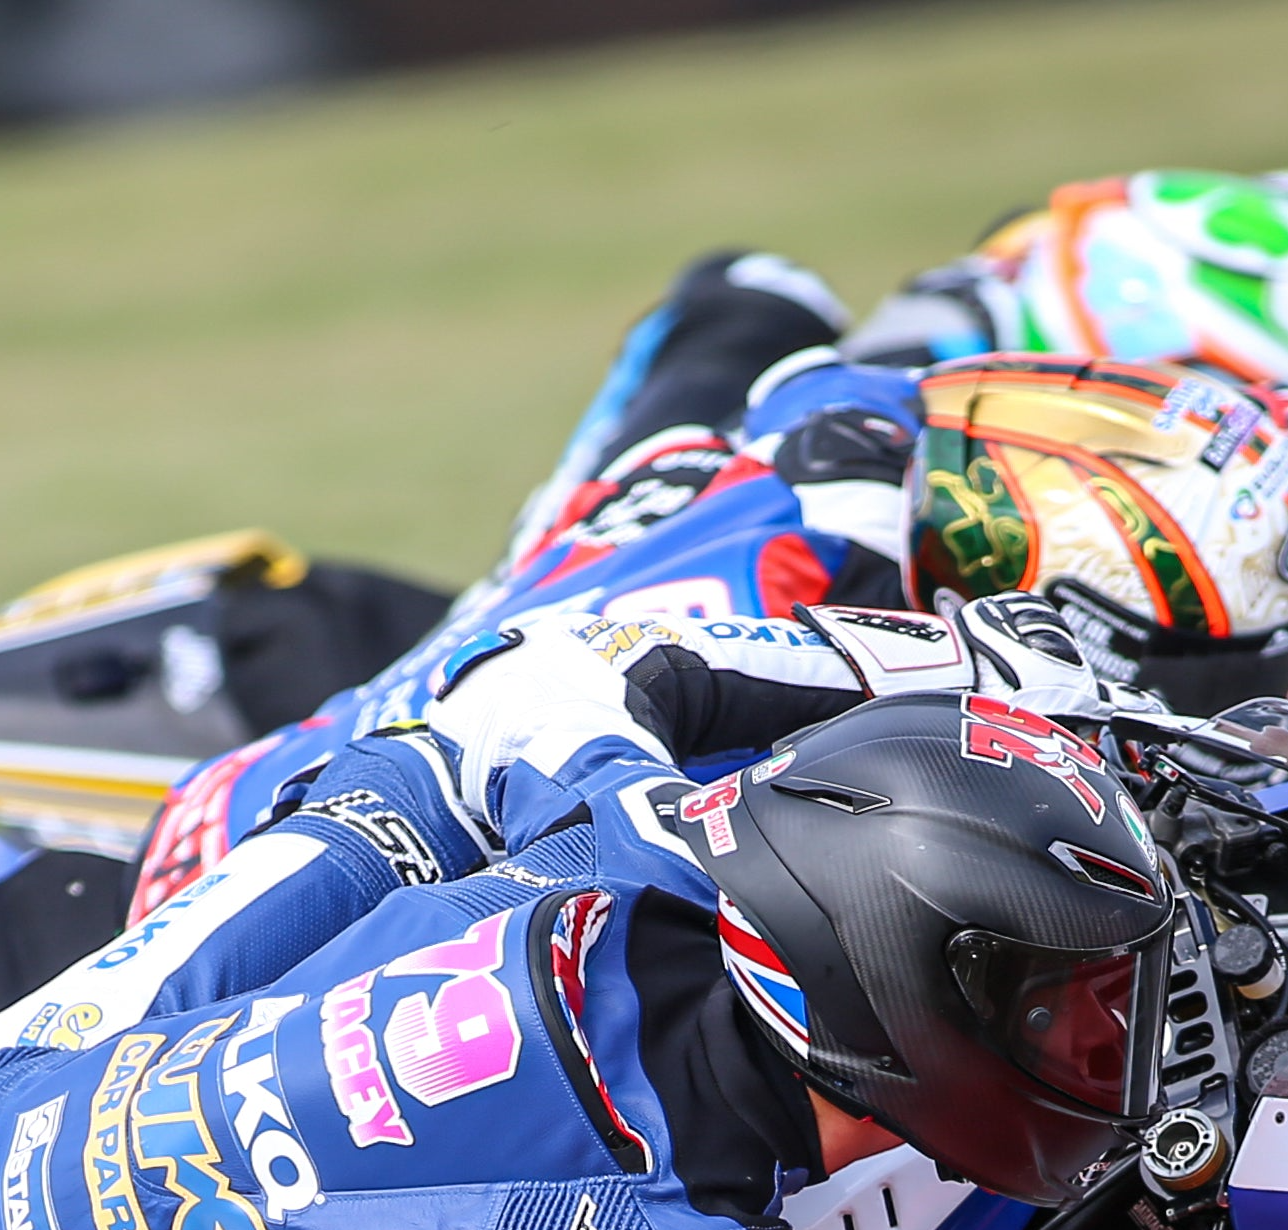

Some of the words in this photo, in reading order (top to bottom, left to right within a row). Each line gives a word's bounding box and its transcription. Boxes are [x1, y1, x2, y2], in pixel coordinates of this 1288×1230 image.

[705, 809, 733, 853] STACEY
[322, 966, 415, 1148] TACEY
[383, 907, 523, 1107] 79
